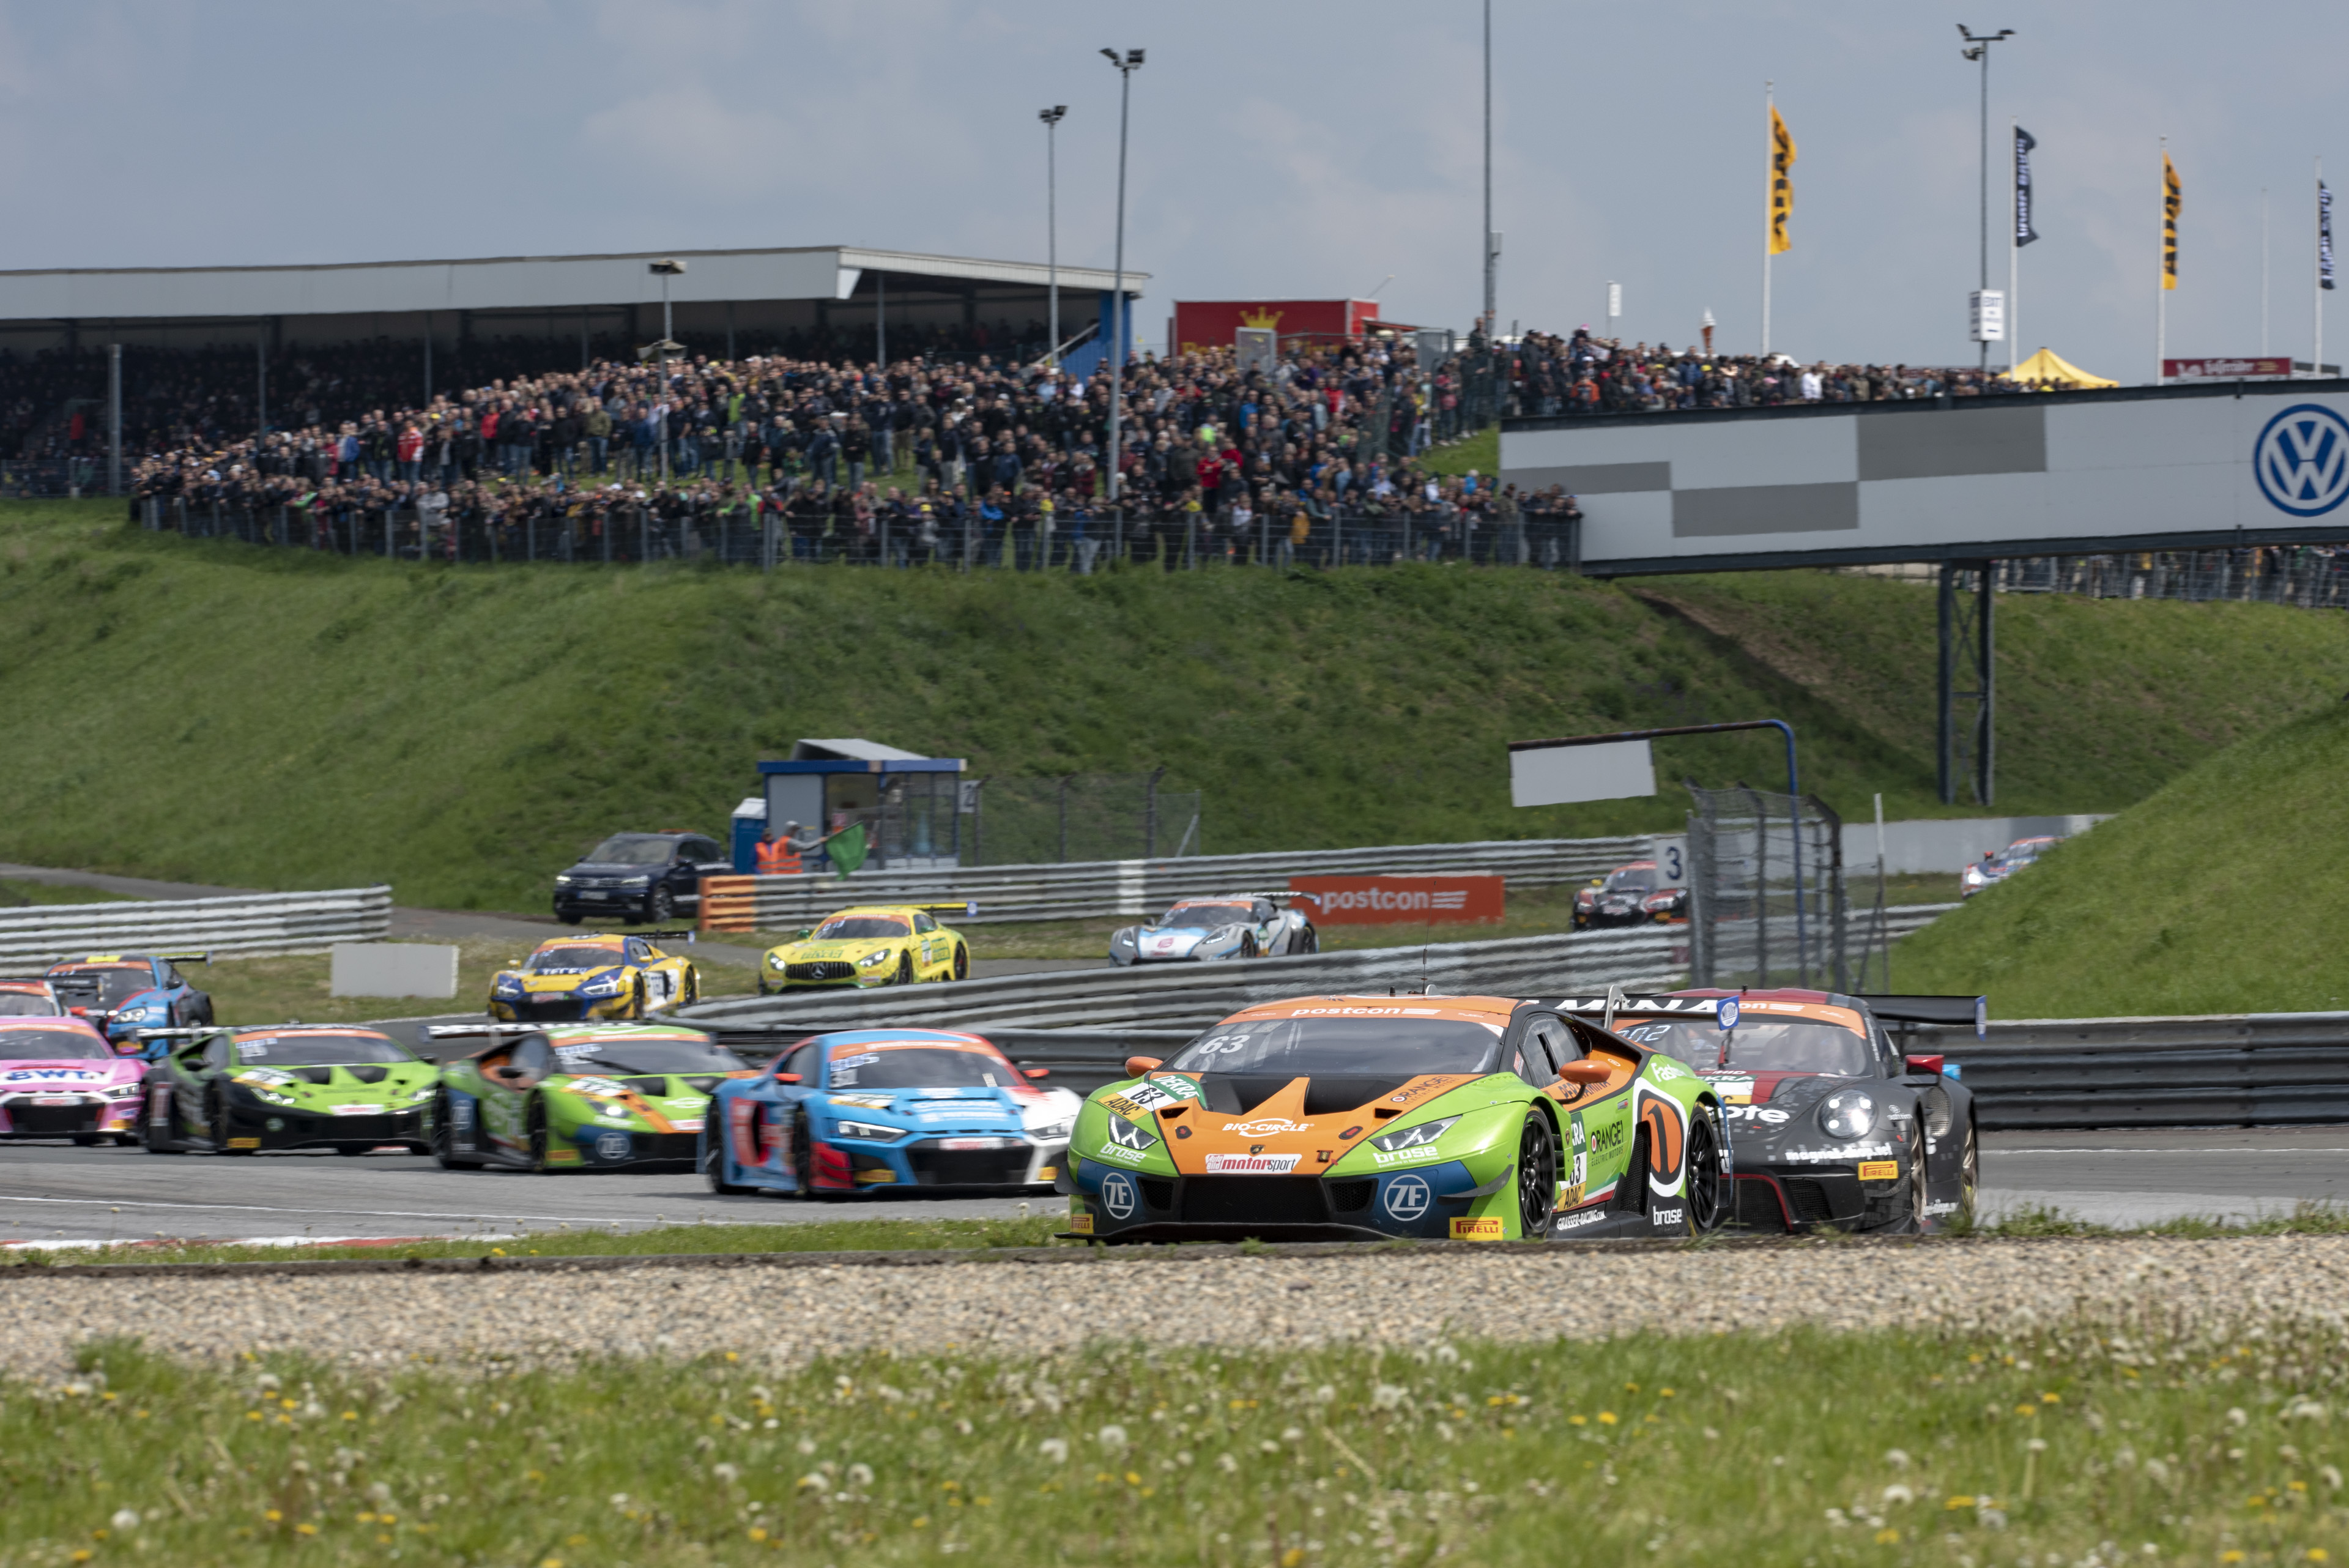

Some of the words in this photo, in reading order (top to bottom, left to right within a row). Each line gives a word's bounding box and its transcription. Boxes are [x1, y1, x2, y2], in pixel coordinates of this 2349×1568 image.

[1666, 846, 1681, 880] 3
[1321, 886, 1429, 915] postcon
[1291, 1007, 1400, 1017] postcon
[1199, 1035, 1250, 1053] 63
[11, 1070, 86, 1080] BWT
[1130, 1087, 1166, 1105] 63
[1153, 1075, 1200, 1099] DEKRA
[1404, 1089, 1433, 1105] ELECTRIC
[1433, 1078, 1460, 1090] MOTORS
[1104, 1098, 1140, 1115] ADAC
[1591, 1120, 1624, 1154] ORANGE1
[1100, 1142, 1146, 1162] brose
[1373, 1146, 1438, 1164] brose
[1609, 1146, 1624, 1159] MOTORS
[1222, 1157, 1296, 1172] motorsport
[1863, 1164, 1894, 1177] PIRELLI
[1104, 1180, 1134, 1211] ZF
[1387, 1183, 1428, 1213] ZF
[1564, 1186, 1581, 1209] ADAC
[1072, 1217, 1089, 1228] PIRELLI
[1653, 1206, 1682, 1225] brose
[1456, 1221, 1498, 1233] PIRELLI
